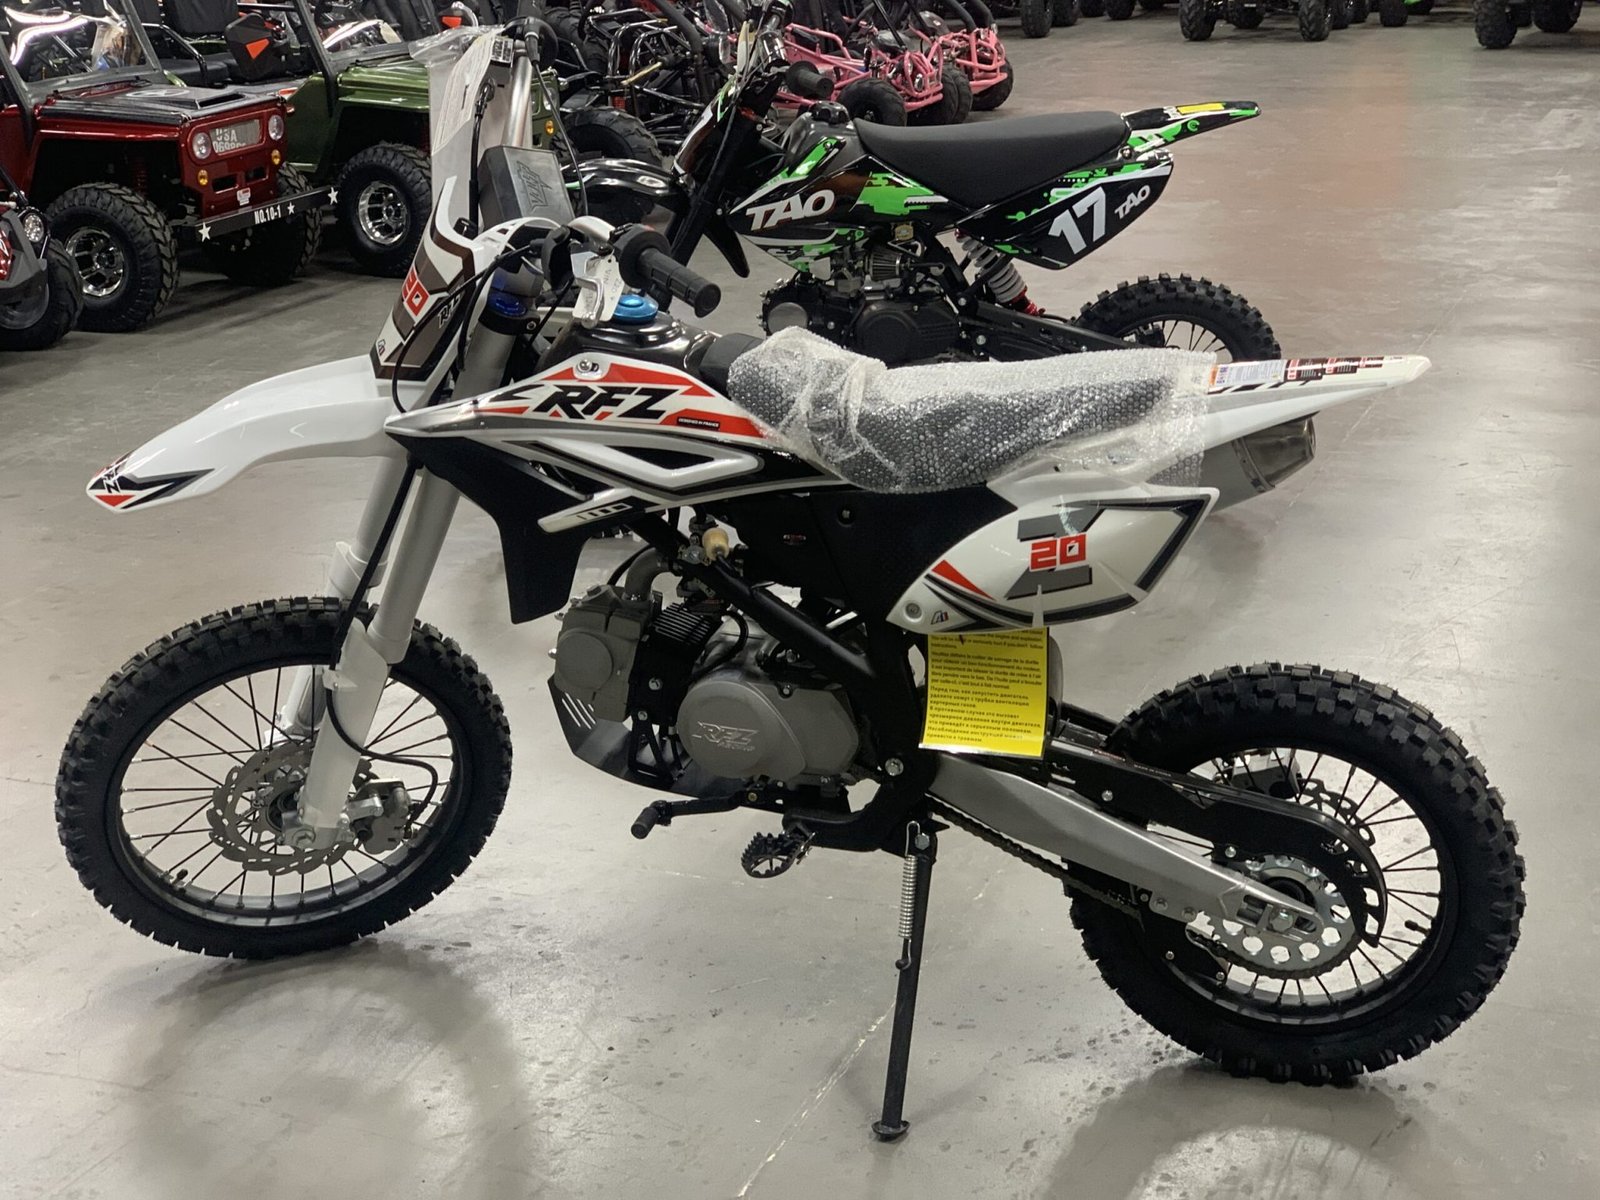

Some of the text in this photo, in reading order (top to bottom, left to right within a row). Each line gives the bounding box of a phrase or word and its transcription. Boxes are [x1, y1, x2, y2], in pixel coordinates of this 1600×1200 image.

[745, 189, 835, 232] TAO
[1048, 186, 1106, 254] 17
[1114, 185, 1150, 219] TAO
[532, 384, 679, 420] RFZ
[1029, 533, 1087, 571] 20
